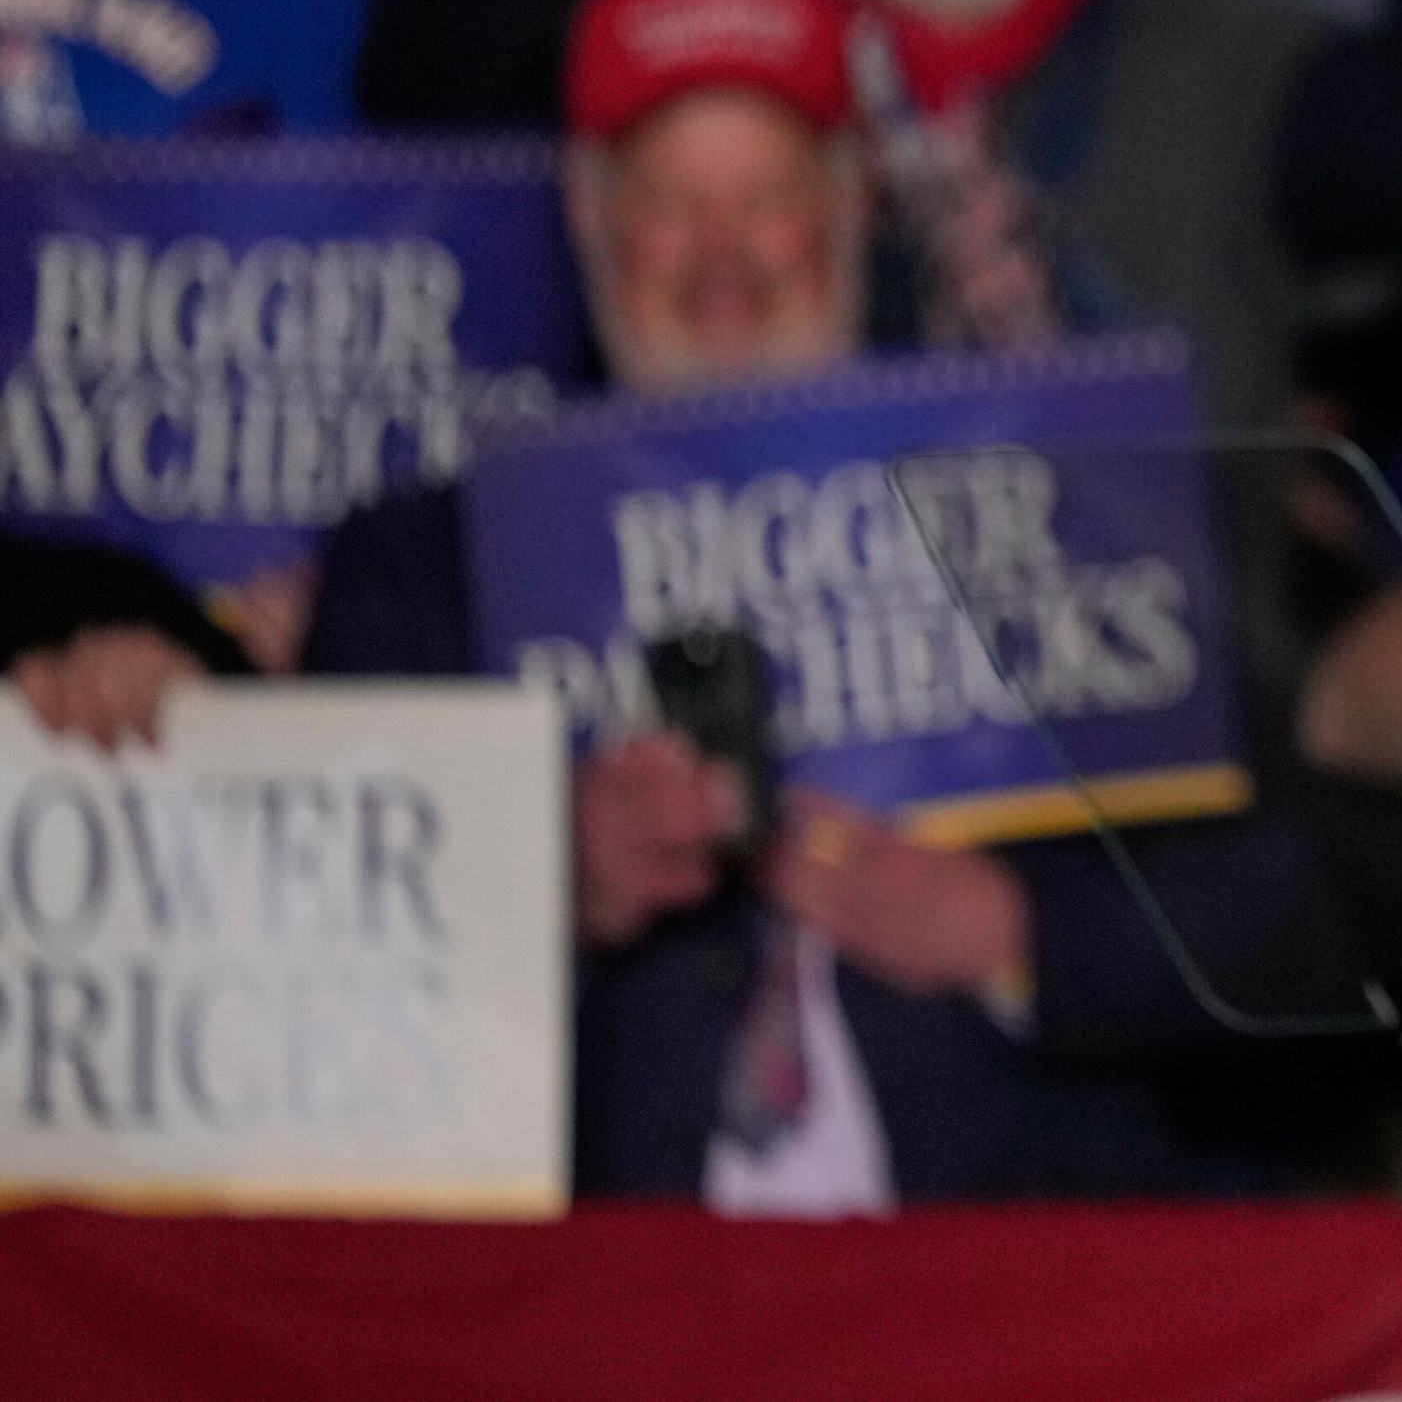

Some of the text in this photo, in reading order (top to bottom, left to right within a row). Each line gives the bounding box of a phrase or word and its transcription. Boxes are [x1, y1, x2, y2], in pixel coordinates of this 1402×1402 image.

[35, 233, 462, 406] BIGGER
[612, 446, 1065, 638] BIGGER
[520, 556, 1198, 756] PHECKS
[0, 770, 456, 948] OWER
[0, 960, 458, 1128] RICES
